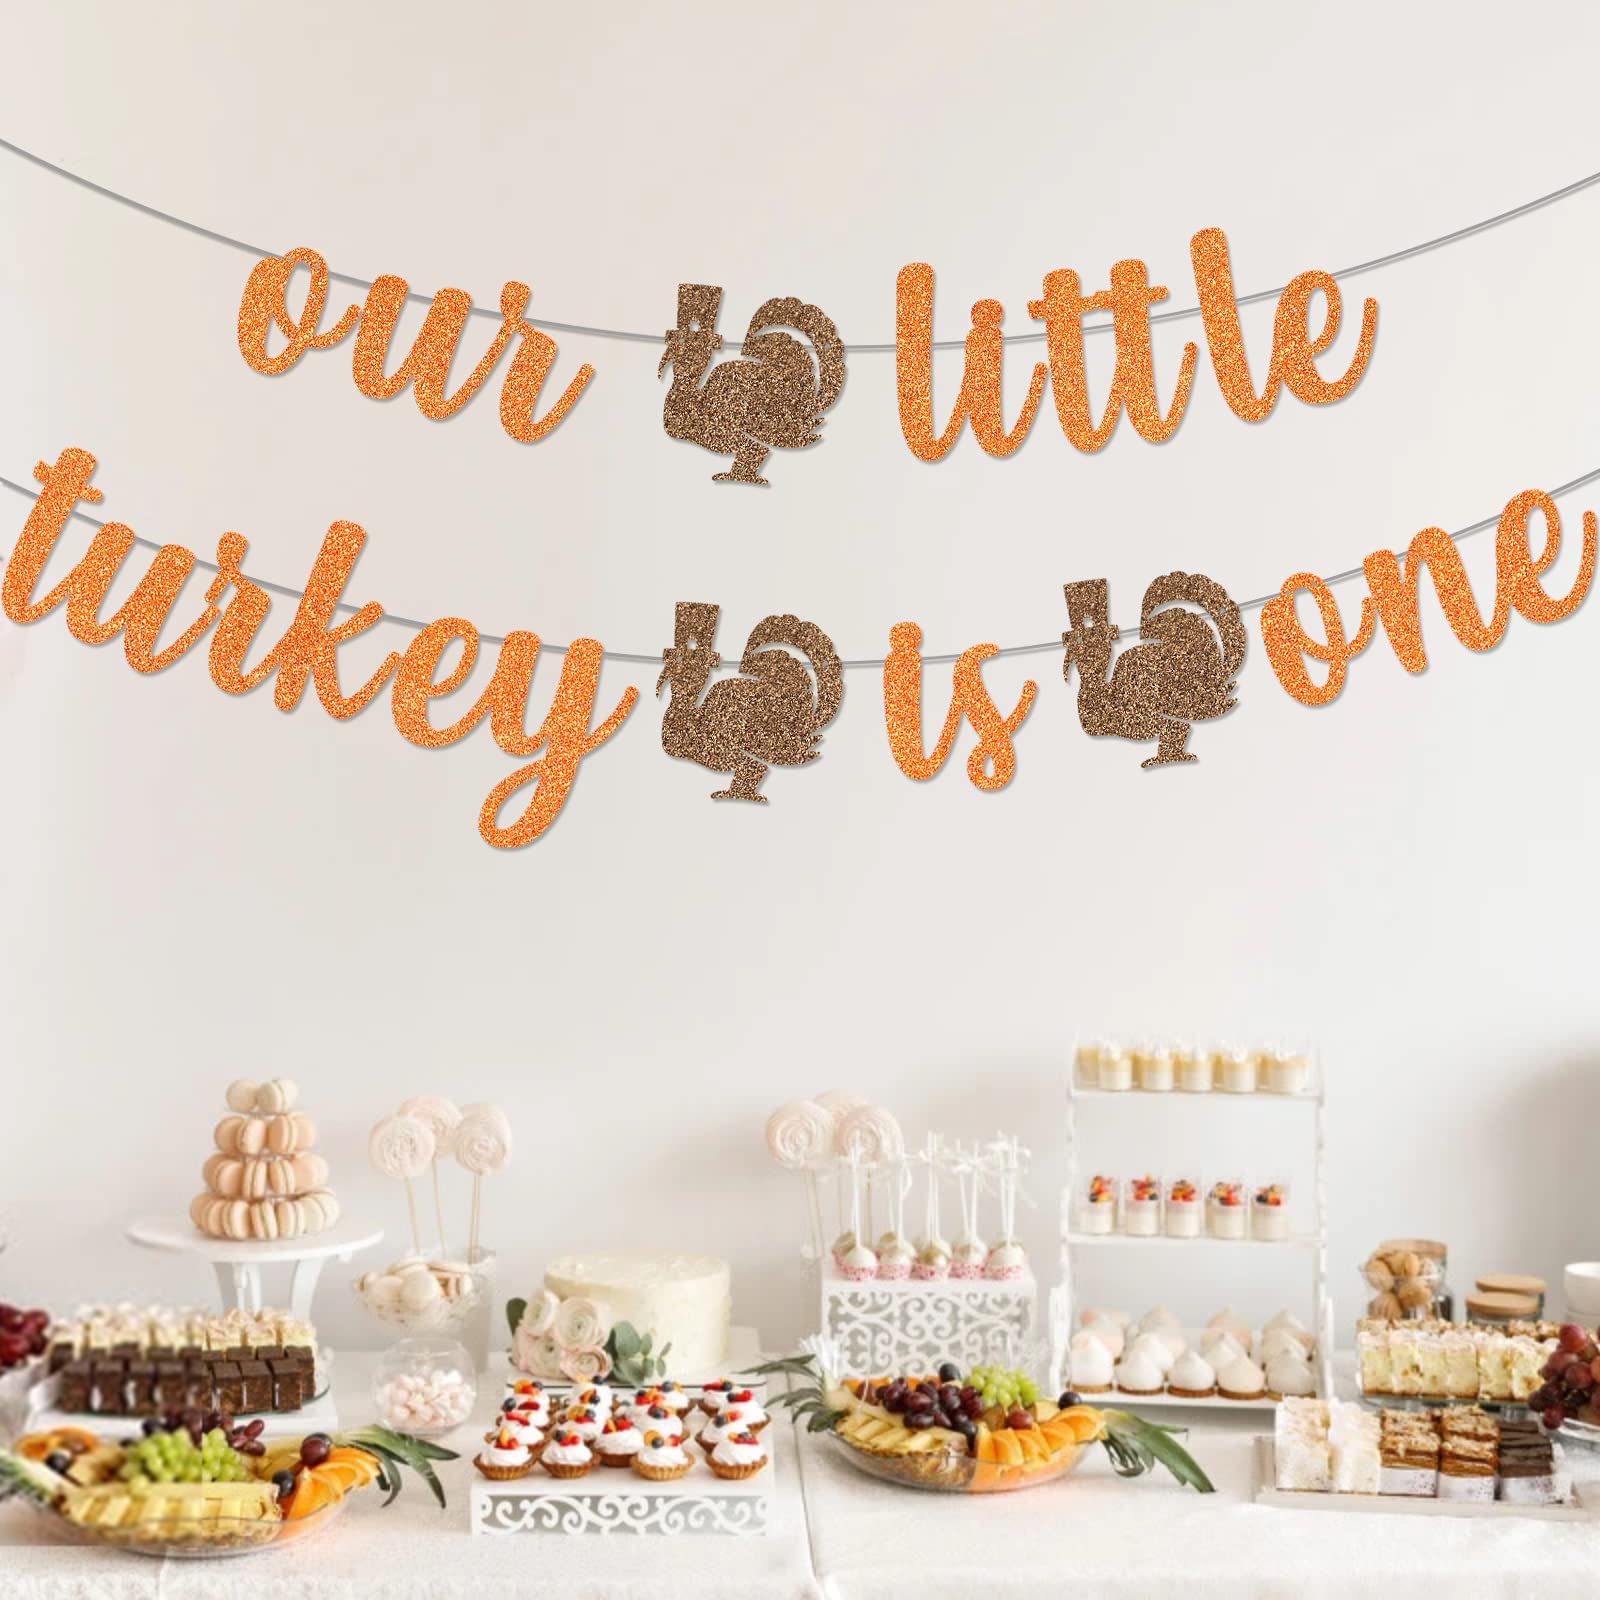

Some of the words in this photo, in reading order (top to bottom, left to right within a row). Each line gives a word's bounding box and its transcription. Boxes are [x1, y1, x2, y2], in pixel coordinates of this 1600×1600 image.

[238, 247, 593, 443] our
[896, 227, 1377, 462] little
[1, 447, 639, 849] turkey
[884, 622, 1037, 791] is
[1260, 489, 1597, 706] one
